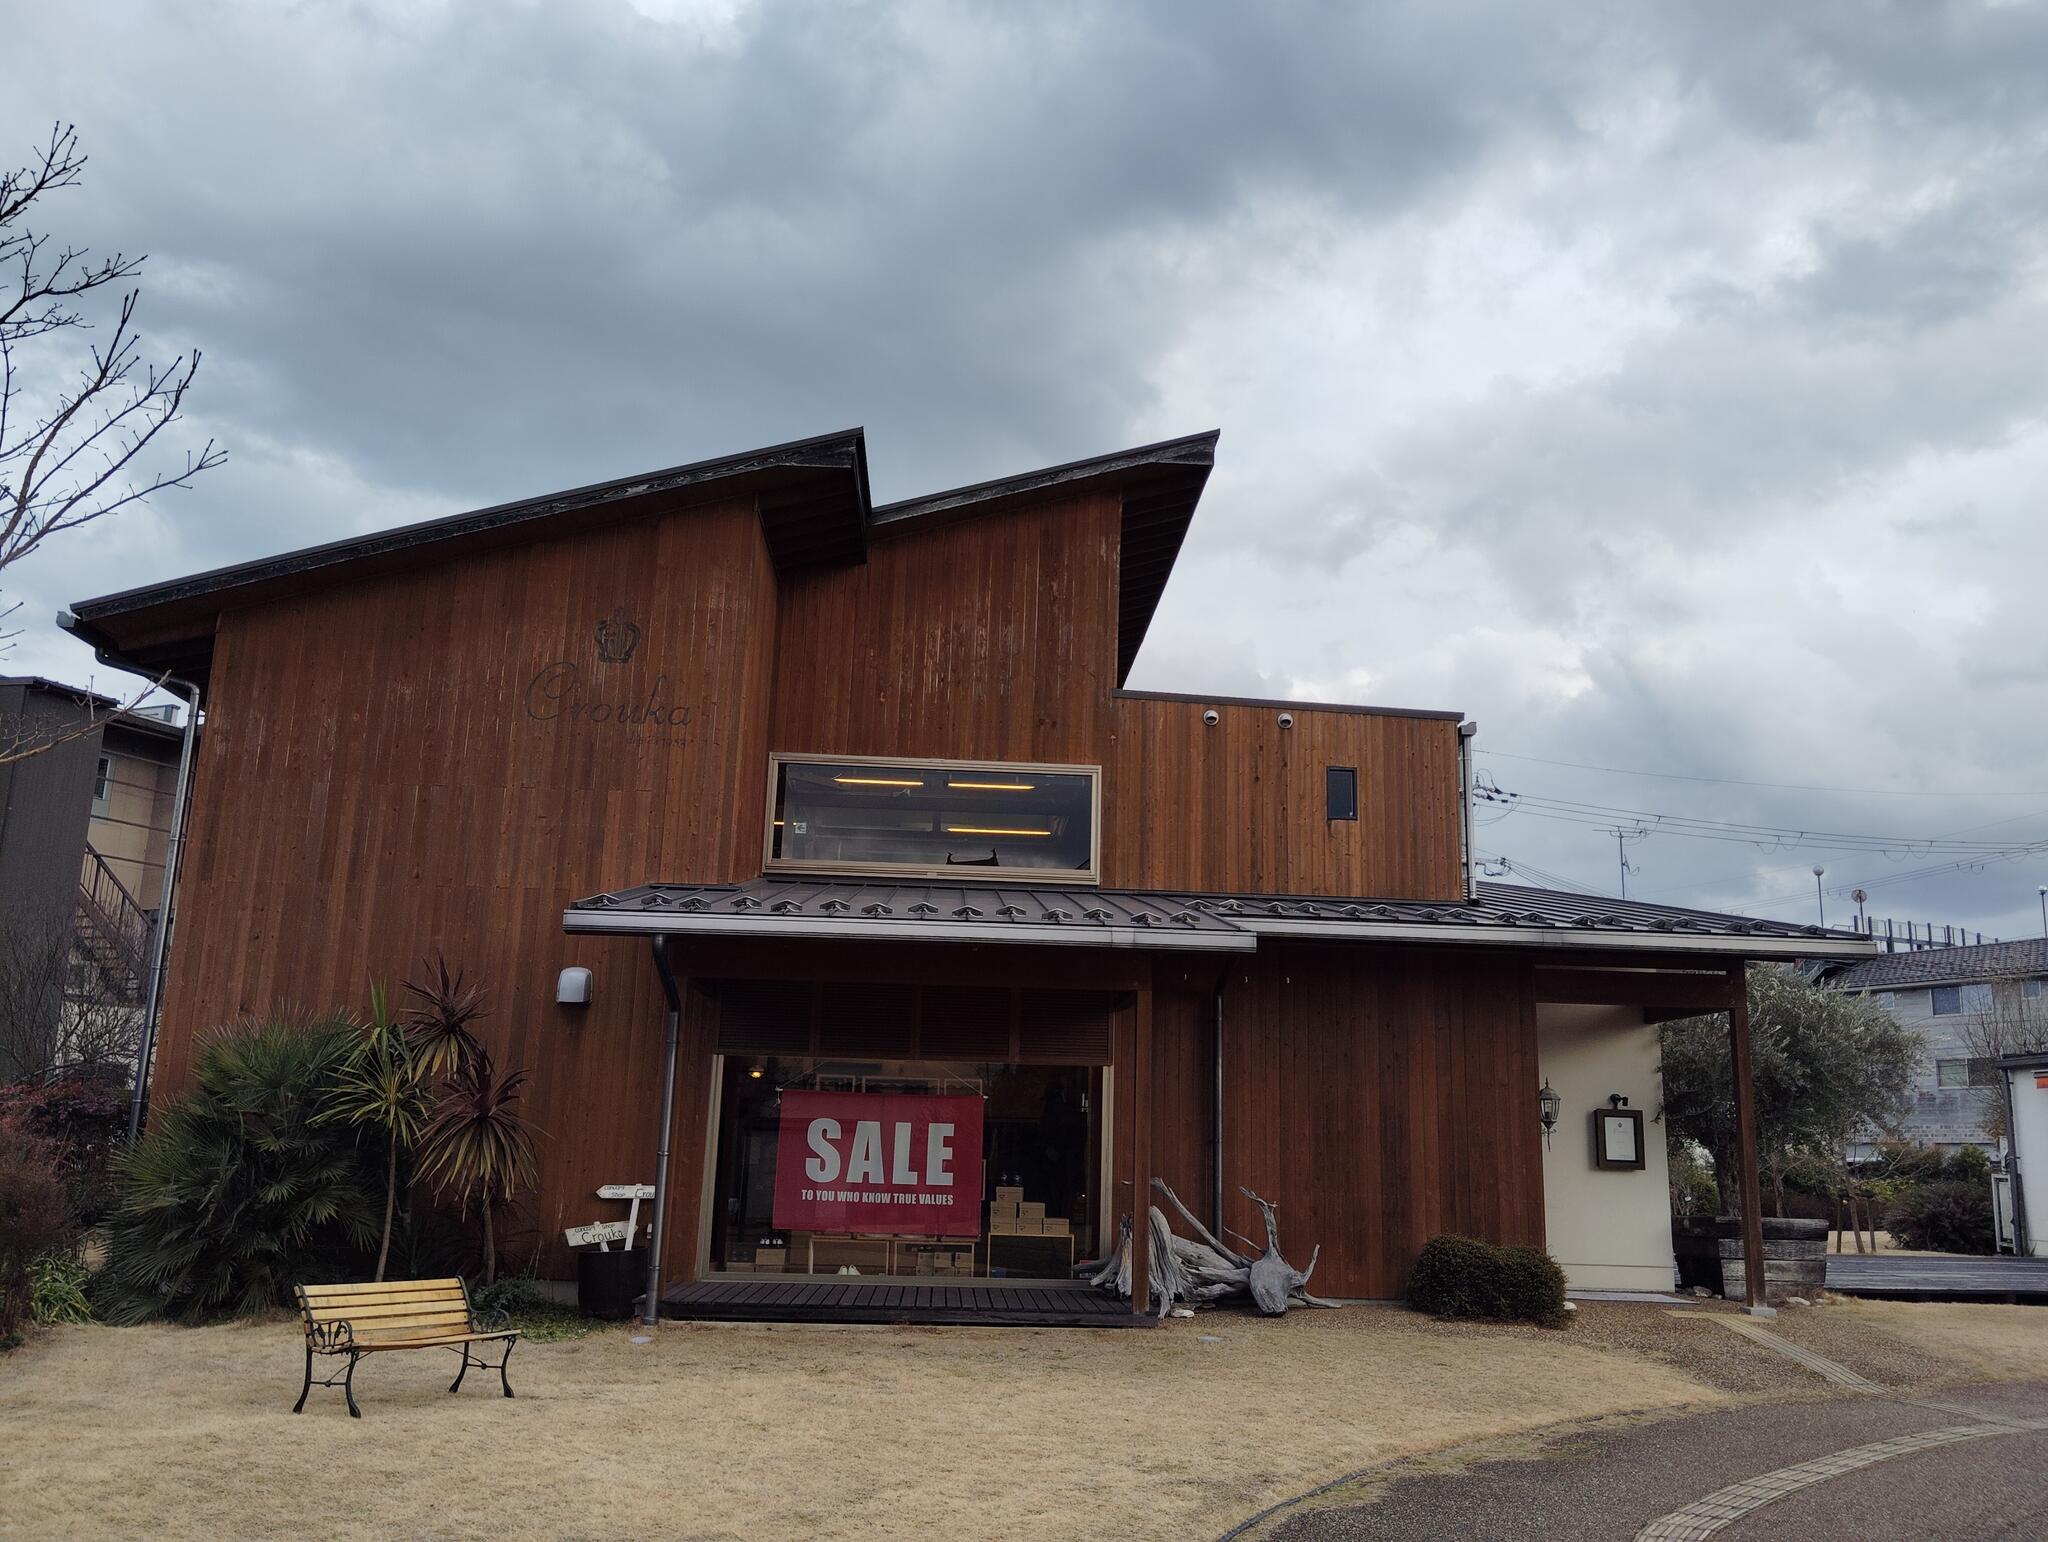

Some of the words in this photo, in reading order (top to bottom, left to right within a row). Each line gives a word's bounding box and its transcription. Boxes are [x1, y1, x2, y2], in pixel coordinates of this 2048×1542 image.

[525, 661, 692, 726] Crouka
[805, 1117, 955, 1186] SALE
[801, 1189, 814, 1200] TO
[816, 1190, 835, 1202] YOU
[837, 1190, 860, 1203] WHO
[862, 1191, 891, 1204] KNOW
[893, 1193, 917, 1205] TRUE
[919, 1193, 954, 1206] VALUES
[581, 1229, 625, 1244] Crouka
